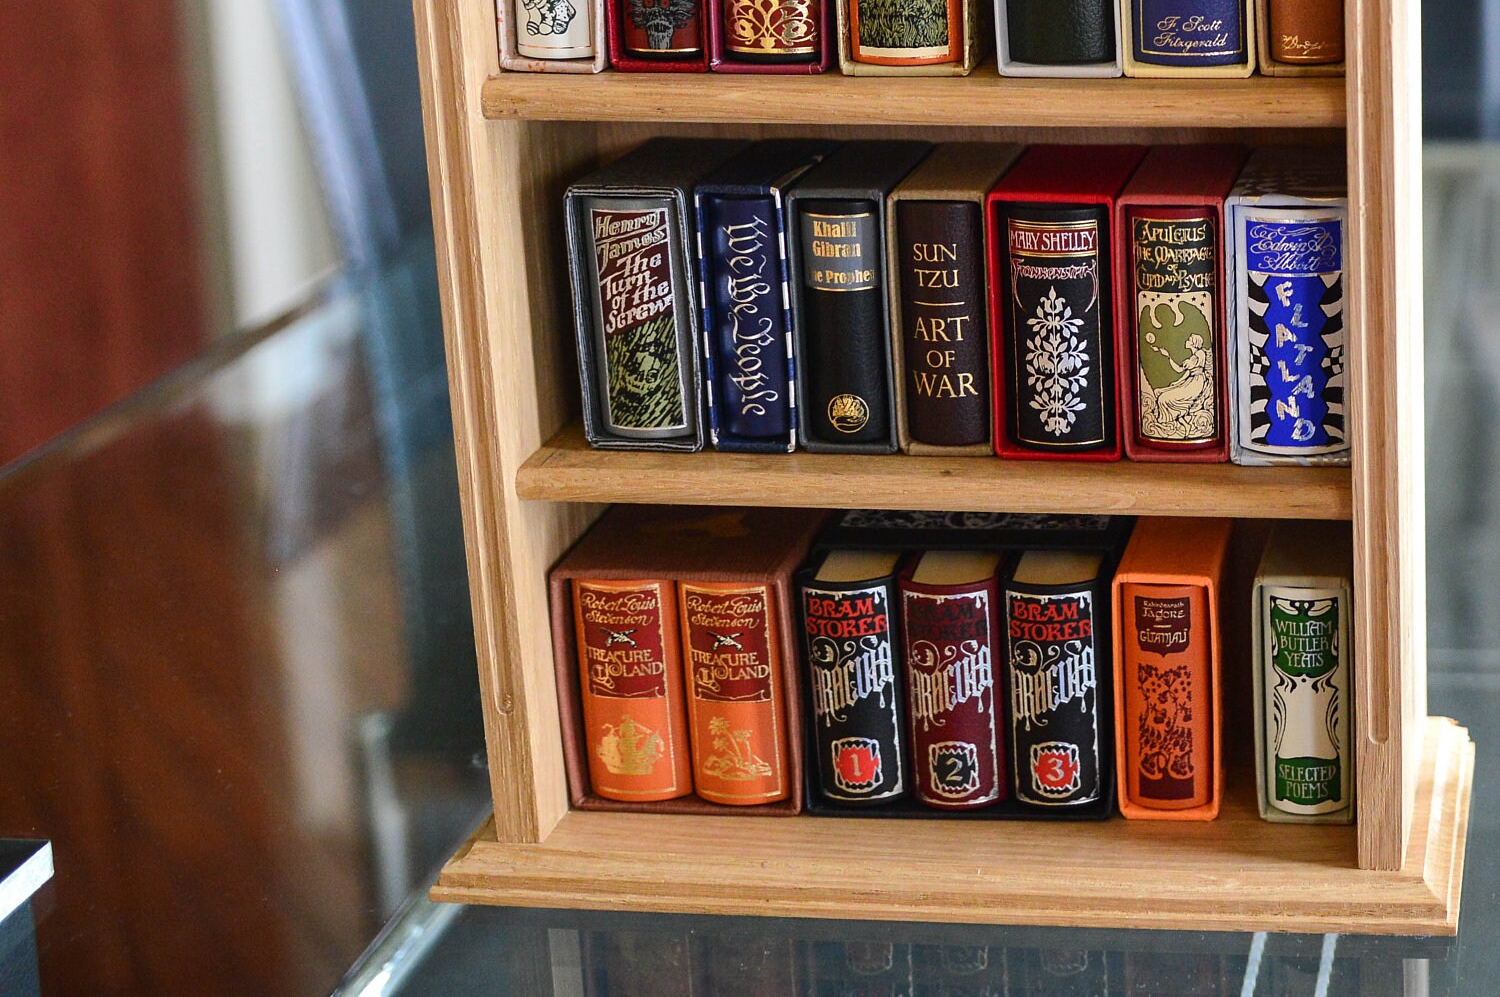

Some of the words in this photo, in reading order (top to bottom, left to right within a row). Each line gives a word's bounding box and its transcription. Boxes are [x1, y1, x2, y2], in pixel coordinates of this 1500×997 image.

[1157, 17, 1179, 32] F.
[1182, 16, 1222, 32] Scott
[1153, 33, 1226, 51] Fitzgerald
[596, 212, 661, 236] Henry
[812, 241, 861, 257] Gibran
[1011, 230, 1038, 249] MARY
[1041, 230, 1095, 251] SHELLEY
[597, 228, 666, 274] James
[913, 243, 957, 262] SUN
[617, 252, 662, 276] The
[600, 270, 658, 300] Turn
[914, 269, 959, 287] TZU
[612, 293, 630, 311] of
[632, 282, 670, 305] the
[607, 294, 673, 333] Screw
[914, 316, 969, 342] ART
[728, 312, 779, 416] People
[926, 351, 955, 368] OF
[913, 373, 979, 398] WAR
[583, 594, 622, 609] Robert
[623, 594, 655, 613] Louis
[808, 597, 873, 617] BRAM
[1014, 603, 1078, 619] BRAM
[586, 610, 653, 626] Stevenson
[807, 616, 887, 637] STOKER
[1276, 619, 1332, 637] WILLIAM
[1010, 619, 1091, 640] STOKER
[1281, 638, 1330, 652] BUTLER
[1284, 653, 1324, 668] YEATS
[852, 753, 862, 777] 1
[945, 757, 962, 781] 2
[1047, 757, 1064, 780] 3
[1279, 765, 1335, 780] SELECTED
[1286, 782, 1328, 798] POEMS
